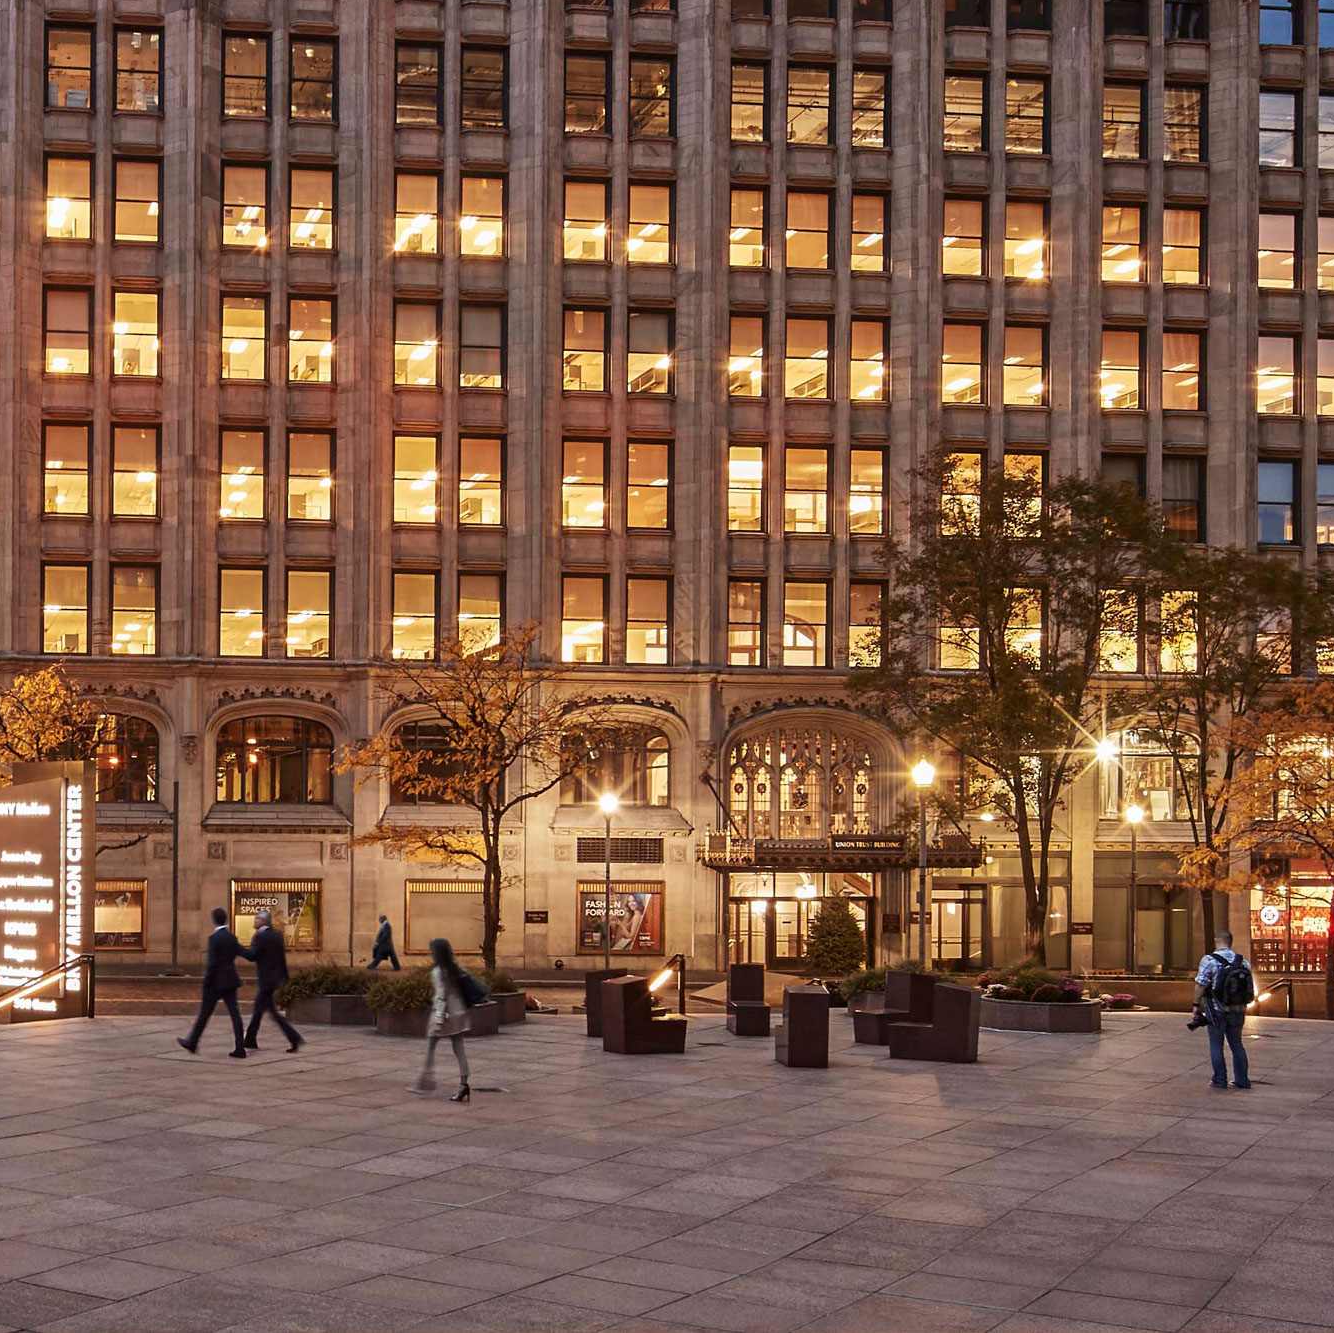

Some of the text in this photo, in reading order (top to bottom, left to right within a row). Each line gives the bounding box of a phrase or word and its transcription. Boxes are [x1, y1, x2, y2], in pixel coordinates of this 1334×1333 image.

[66, 784, 82, 863] CENTER
[66, 865, 82, 946] MELLON
[240, 897, 278, 905] INSPIRED
[585, 900, 621, 909] FASHN
